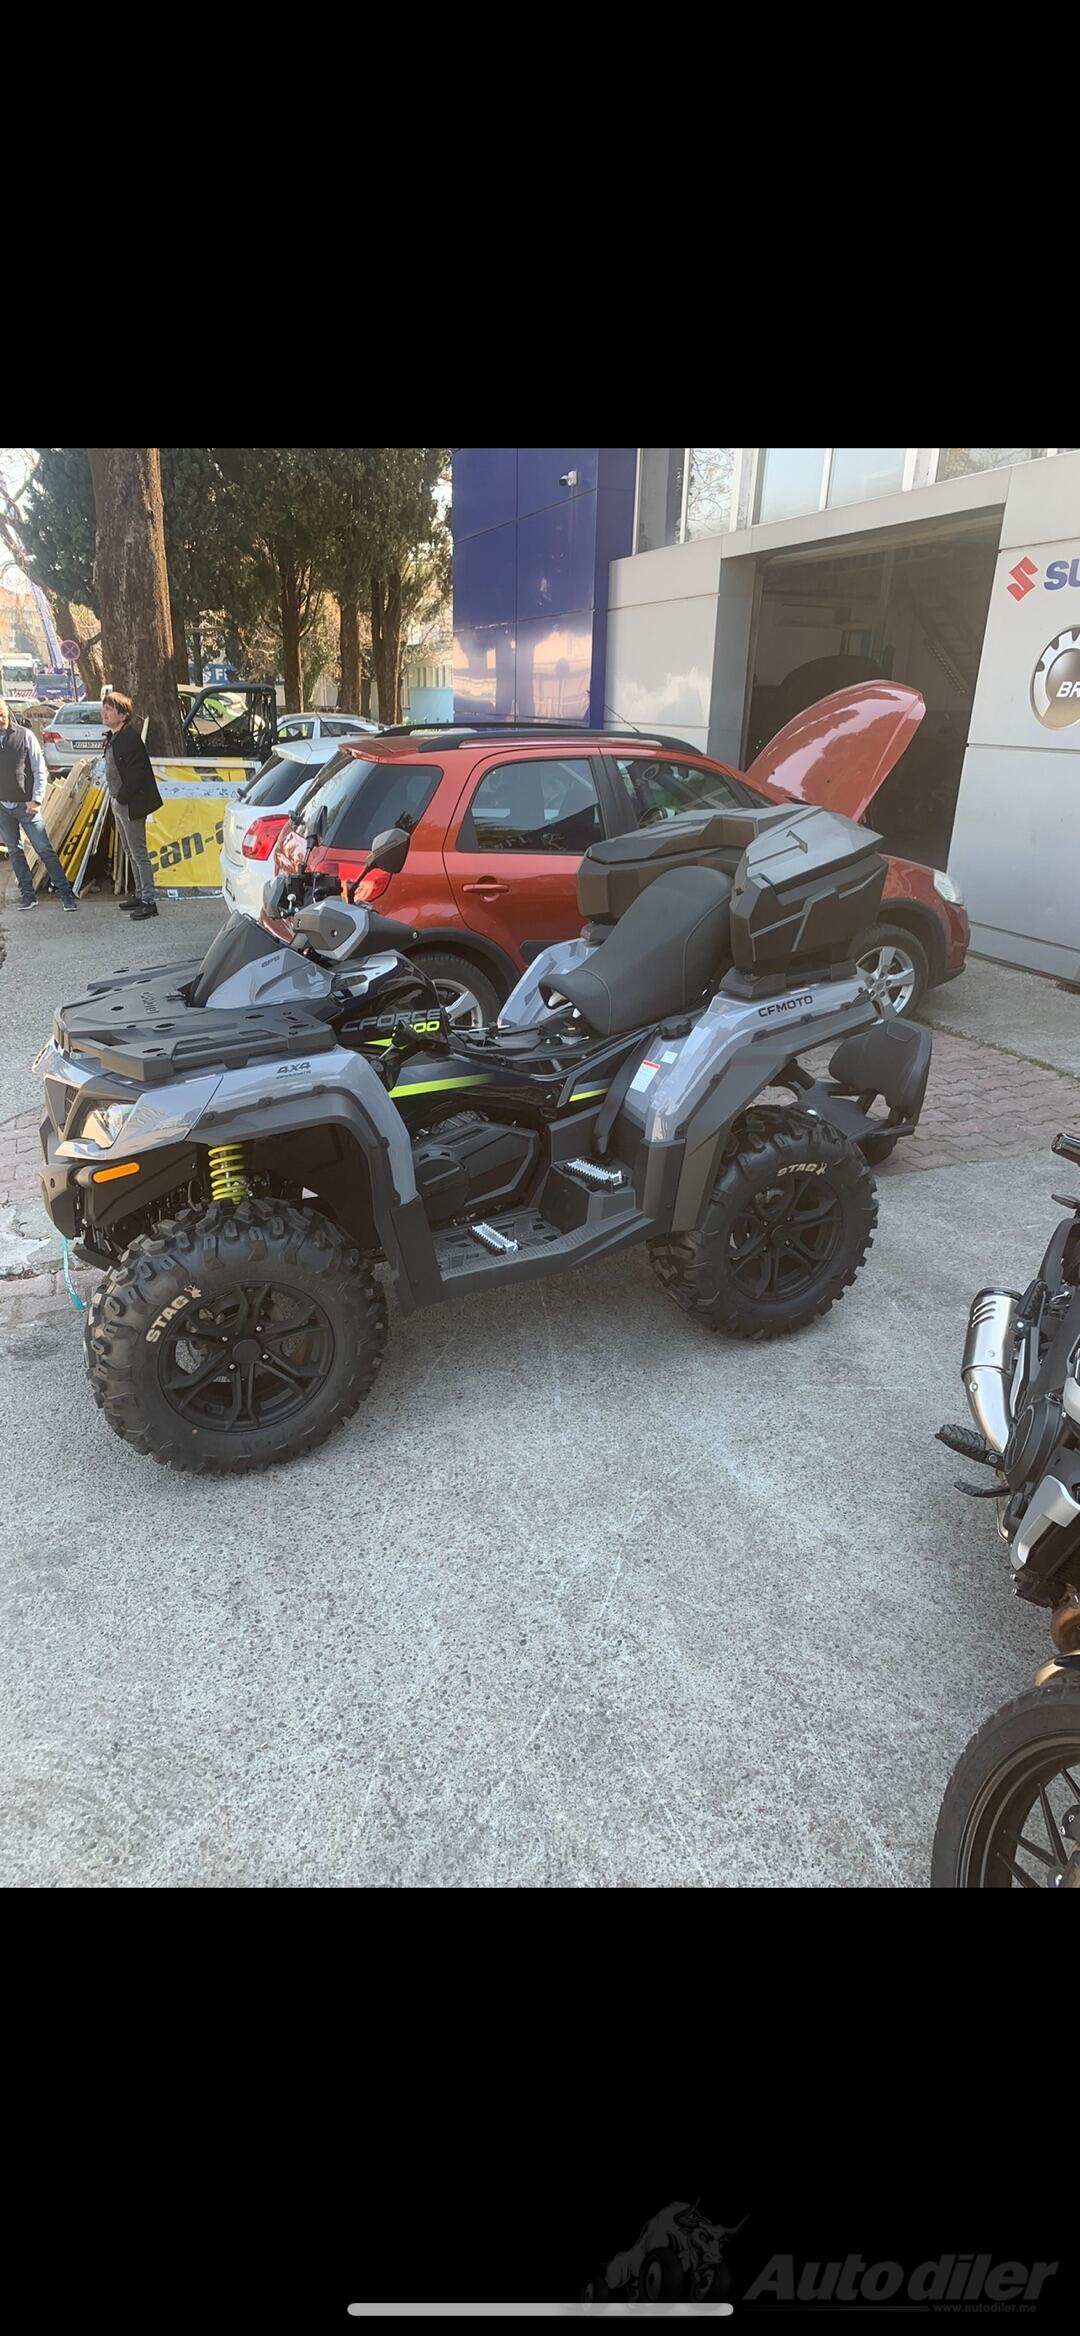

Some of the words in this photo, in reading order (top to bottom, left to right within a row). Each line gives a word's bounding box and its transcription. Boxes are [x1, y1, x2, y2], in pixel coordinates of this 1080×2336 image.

[1055, 680, 1080, 698] BR
[758, 995, 813, 1018] CFMOTO
[410, 1021, 440, 1033] 00
[777, 1163, 818, 1177] STAG
[145, 1295, 190, 1343] STAG
